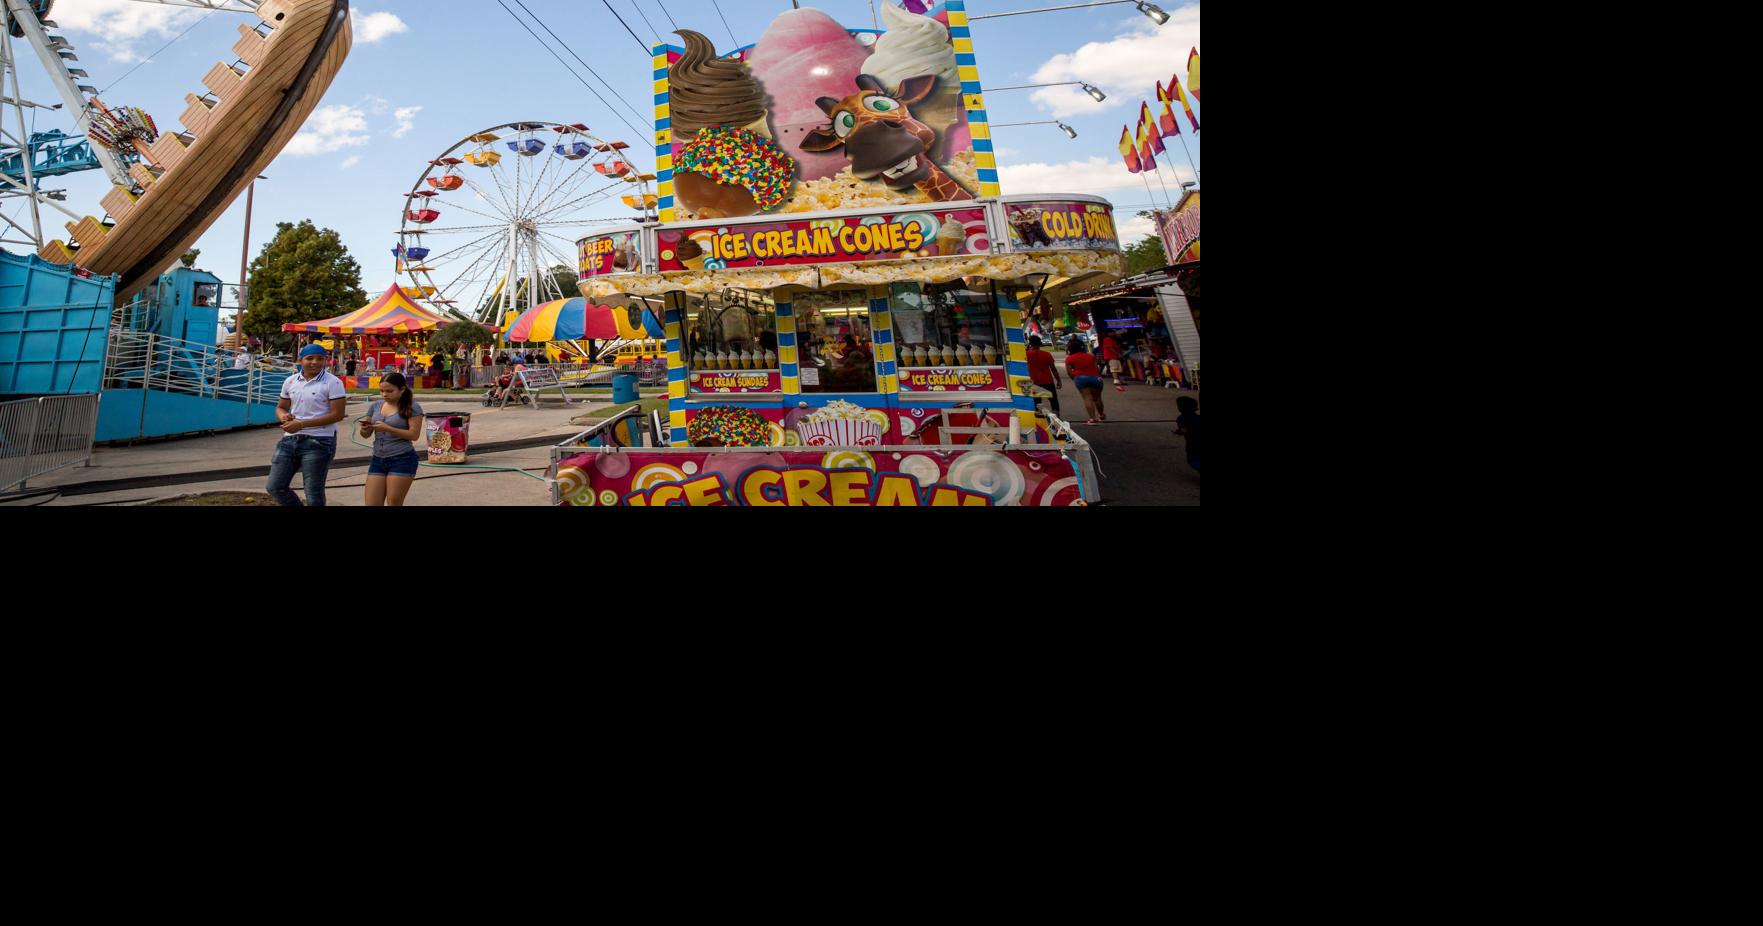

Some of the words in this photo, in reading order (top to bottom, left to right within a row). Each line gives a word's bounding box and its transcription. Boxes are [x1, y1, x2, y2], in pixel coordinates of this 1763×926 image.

[1041, 211, 1083, 238] COLD
[586, 239, 613, 256] BEER
[712, 233, 748, 259] ICE
[752, 226, 836, 257] CREAM
[839, 221, 924, 251] CONES
[703, 377, 713, 387] ICE
[714, 377, 737, 387] CREAM
[738, 376, 769, 387] SUNDAES
[912, 374, 926, 385] ICE
[927, 374, 960, 385] CREAM
[961, 373, 992, 384] CONES
[627, 475, 726, 506] CE
